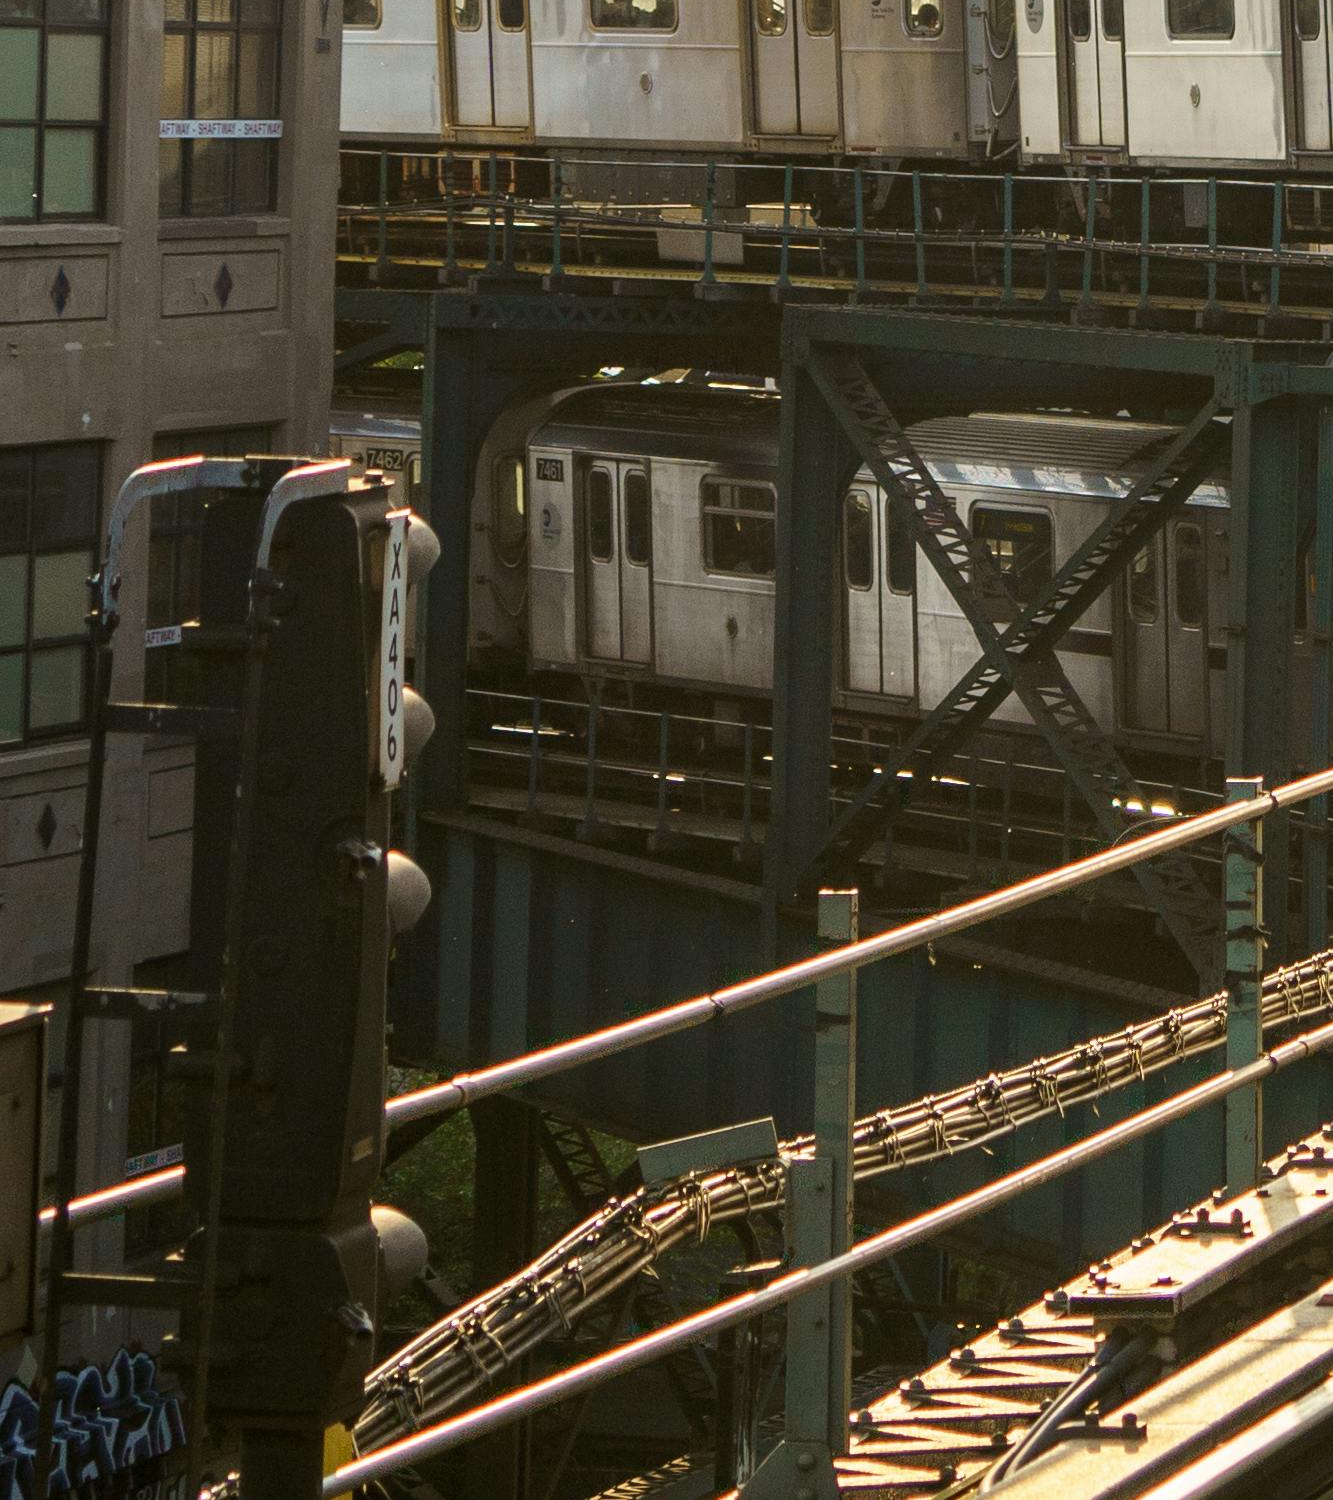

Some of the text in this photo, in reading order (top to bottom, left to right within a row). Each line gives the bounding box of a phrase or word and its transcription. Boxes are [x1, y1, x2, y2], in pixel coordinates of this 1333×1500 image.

[198, 122, 236, 135] SHAFTWAY
[244, 122, 281, 135] SHAFTWAY
[367, 449, 402, 470] 7462
[538, 461, 562, 481] 7461
